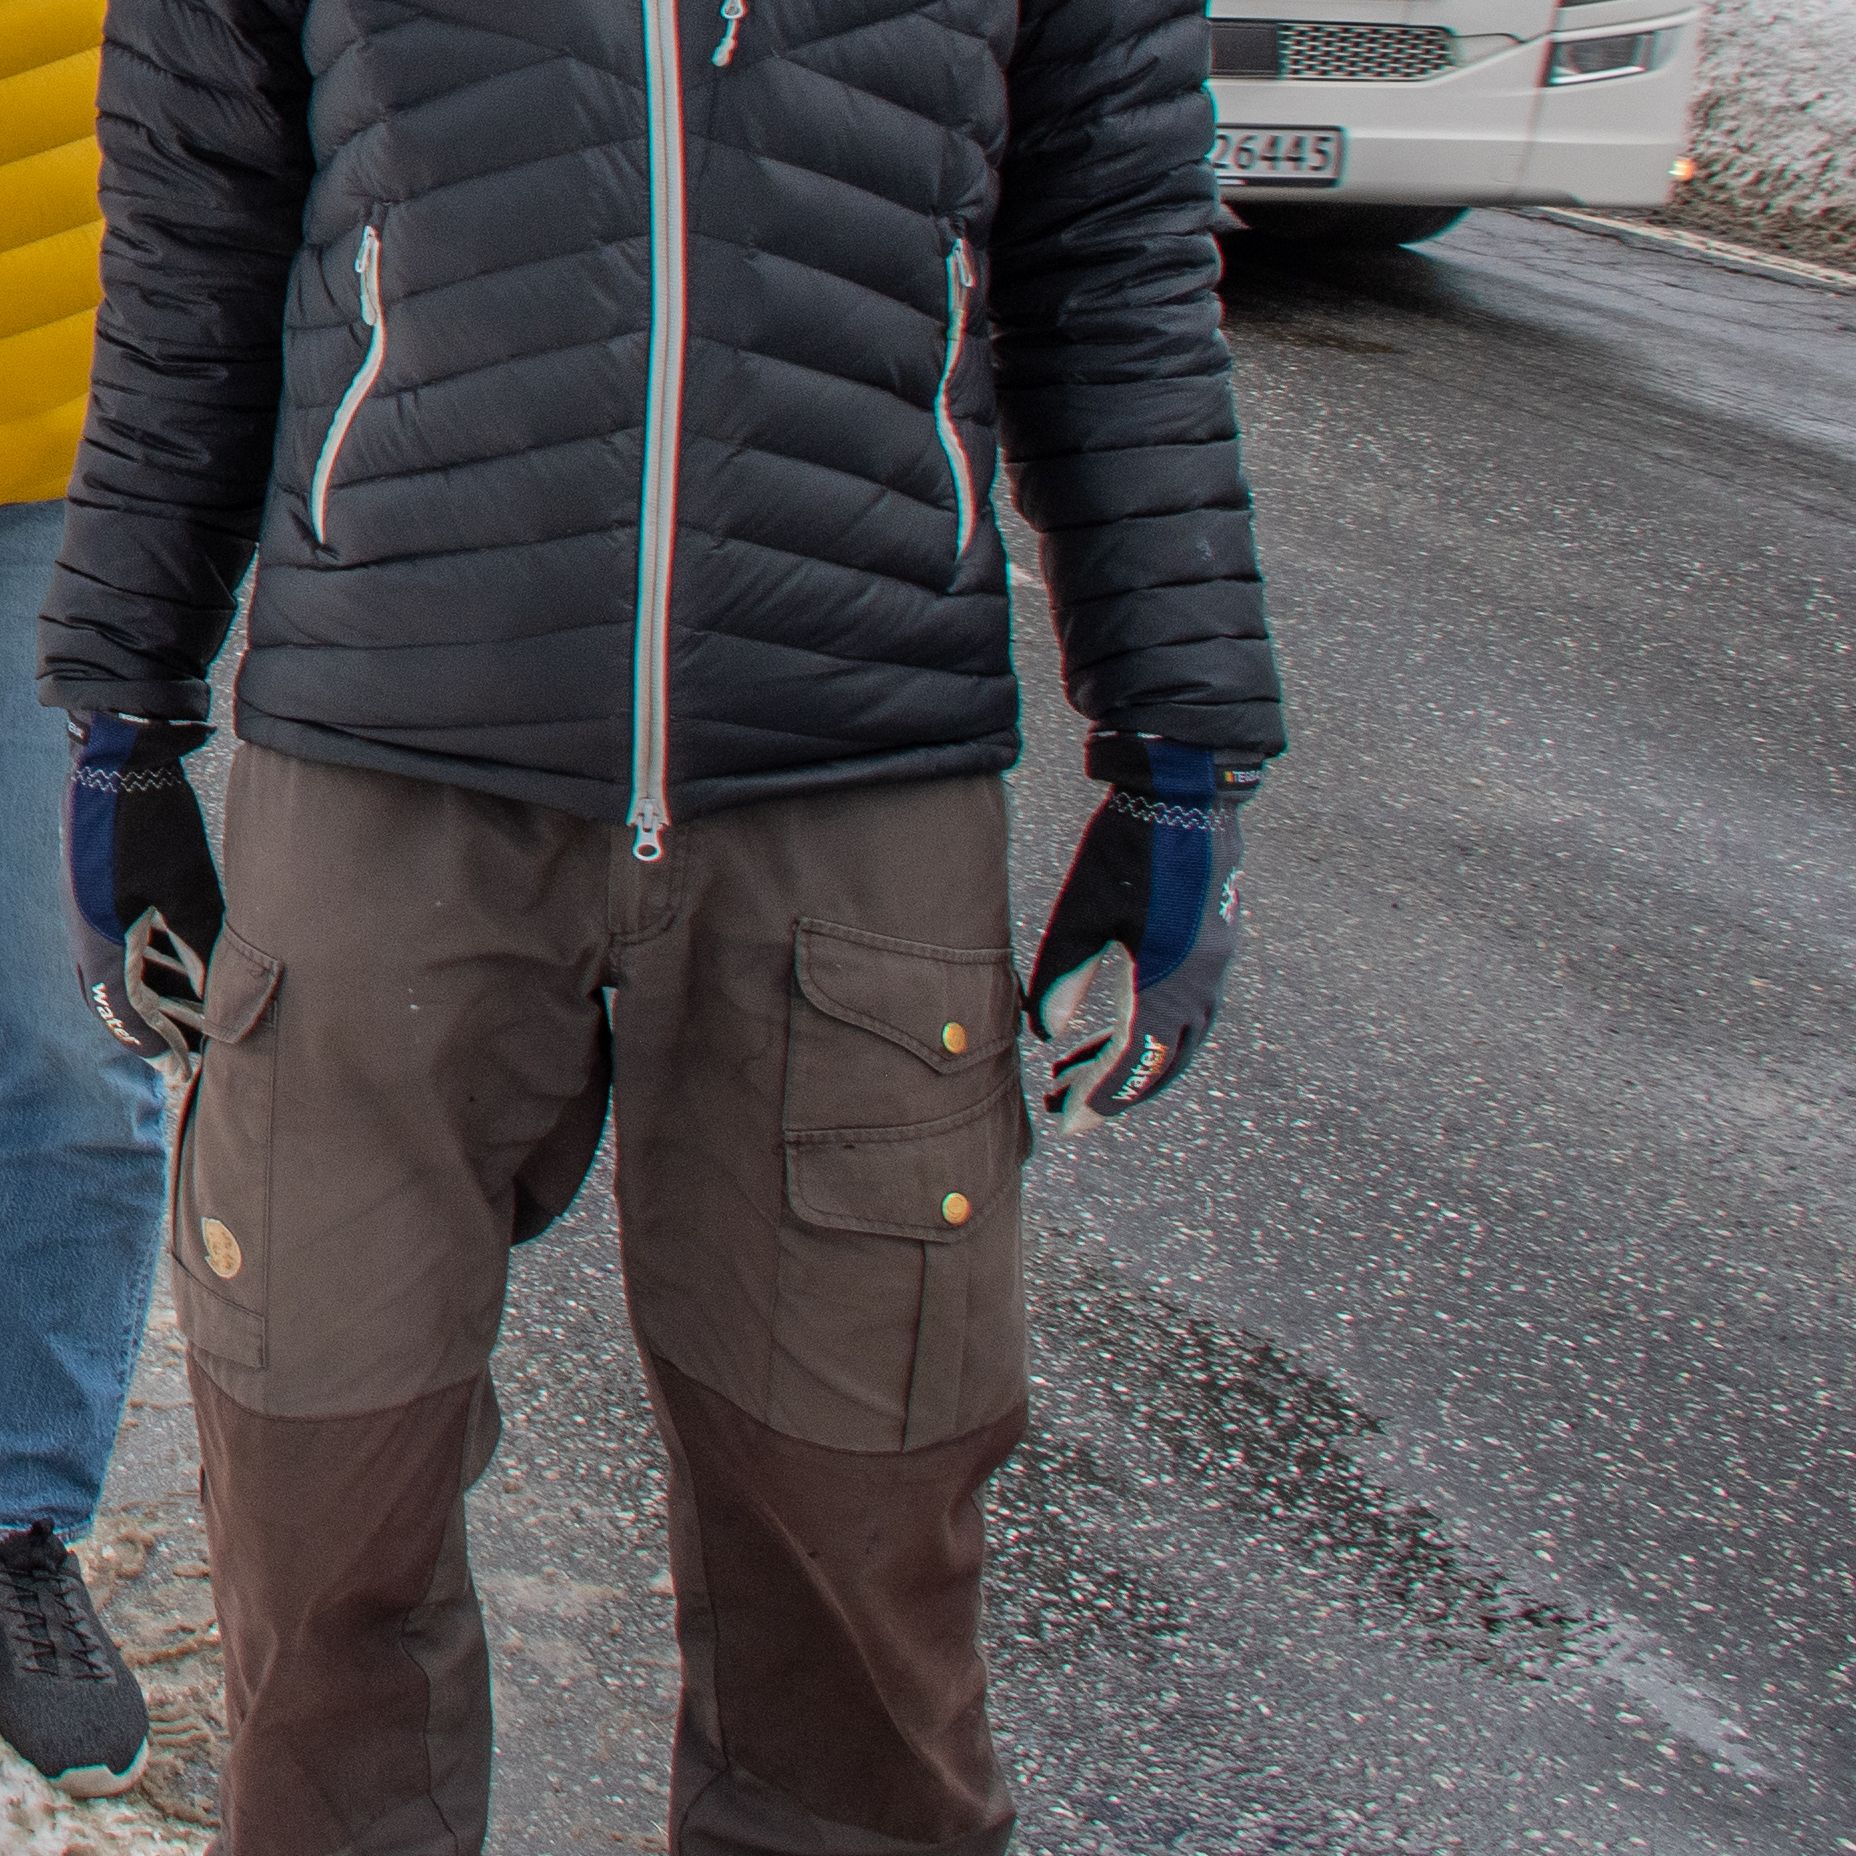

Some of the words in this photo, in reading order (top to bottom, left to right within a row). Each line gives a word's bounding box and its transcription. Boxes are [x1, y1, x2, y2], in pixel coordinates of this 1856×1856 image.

[1212, 133, 1330, 172] 26445
[91, 981, 142, 1047] water
[1111, 1033, 1165, 1101] water
